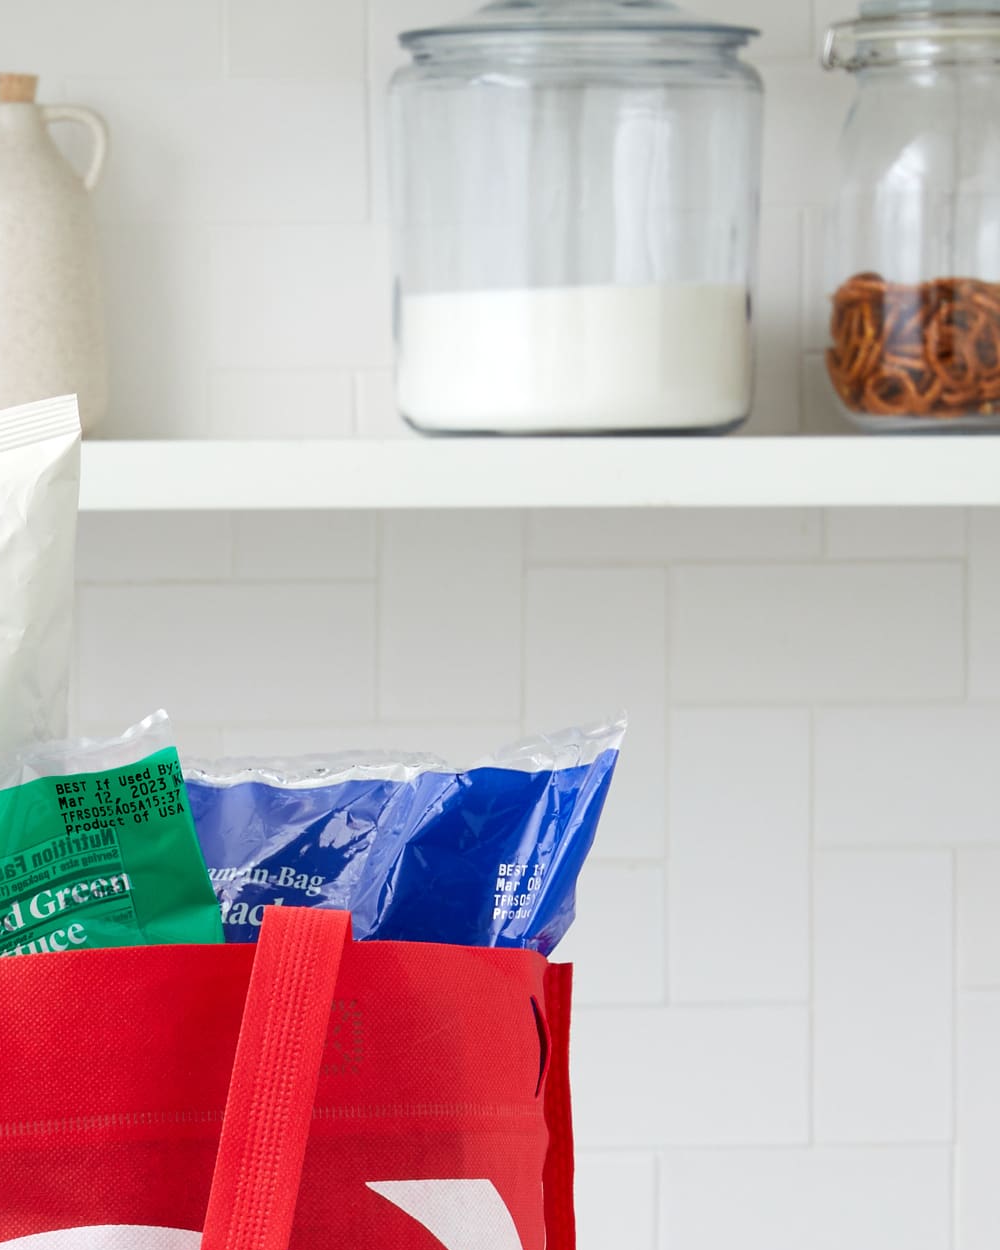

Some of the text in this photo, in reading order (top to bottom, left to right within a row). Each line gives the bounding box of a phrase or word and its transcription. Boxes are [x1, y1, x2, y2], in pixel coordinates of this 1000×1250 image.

[56, 761, 179, 796] BEST If Used By:
[58, 796, 85, 811] Mar
[131, 778, 167, 799] 2023
[66, 816, 125, 836] Product
[159, 802, 185, 818] USA
[495, 877, 520, 892] Mar
[498, 863, 528, 877] BEST
[30, 872, 131, 919] Green
